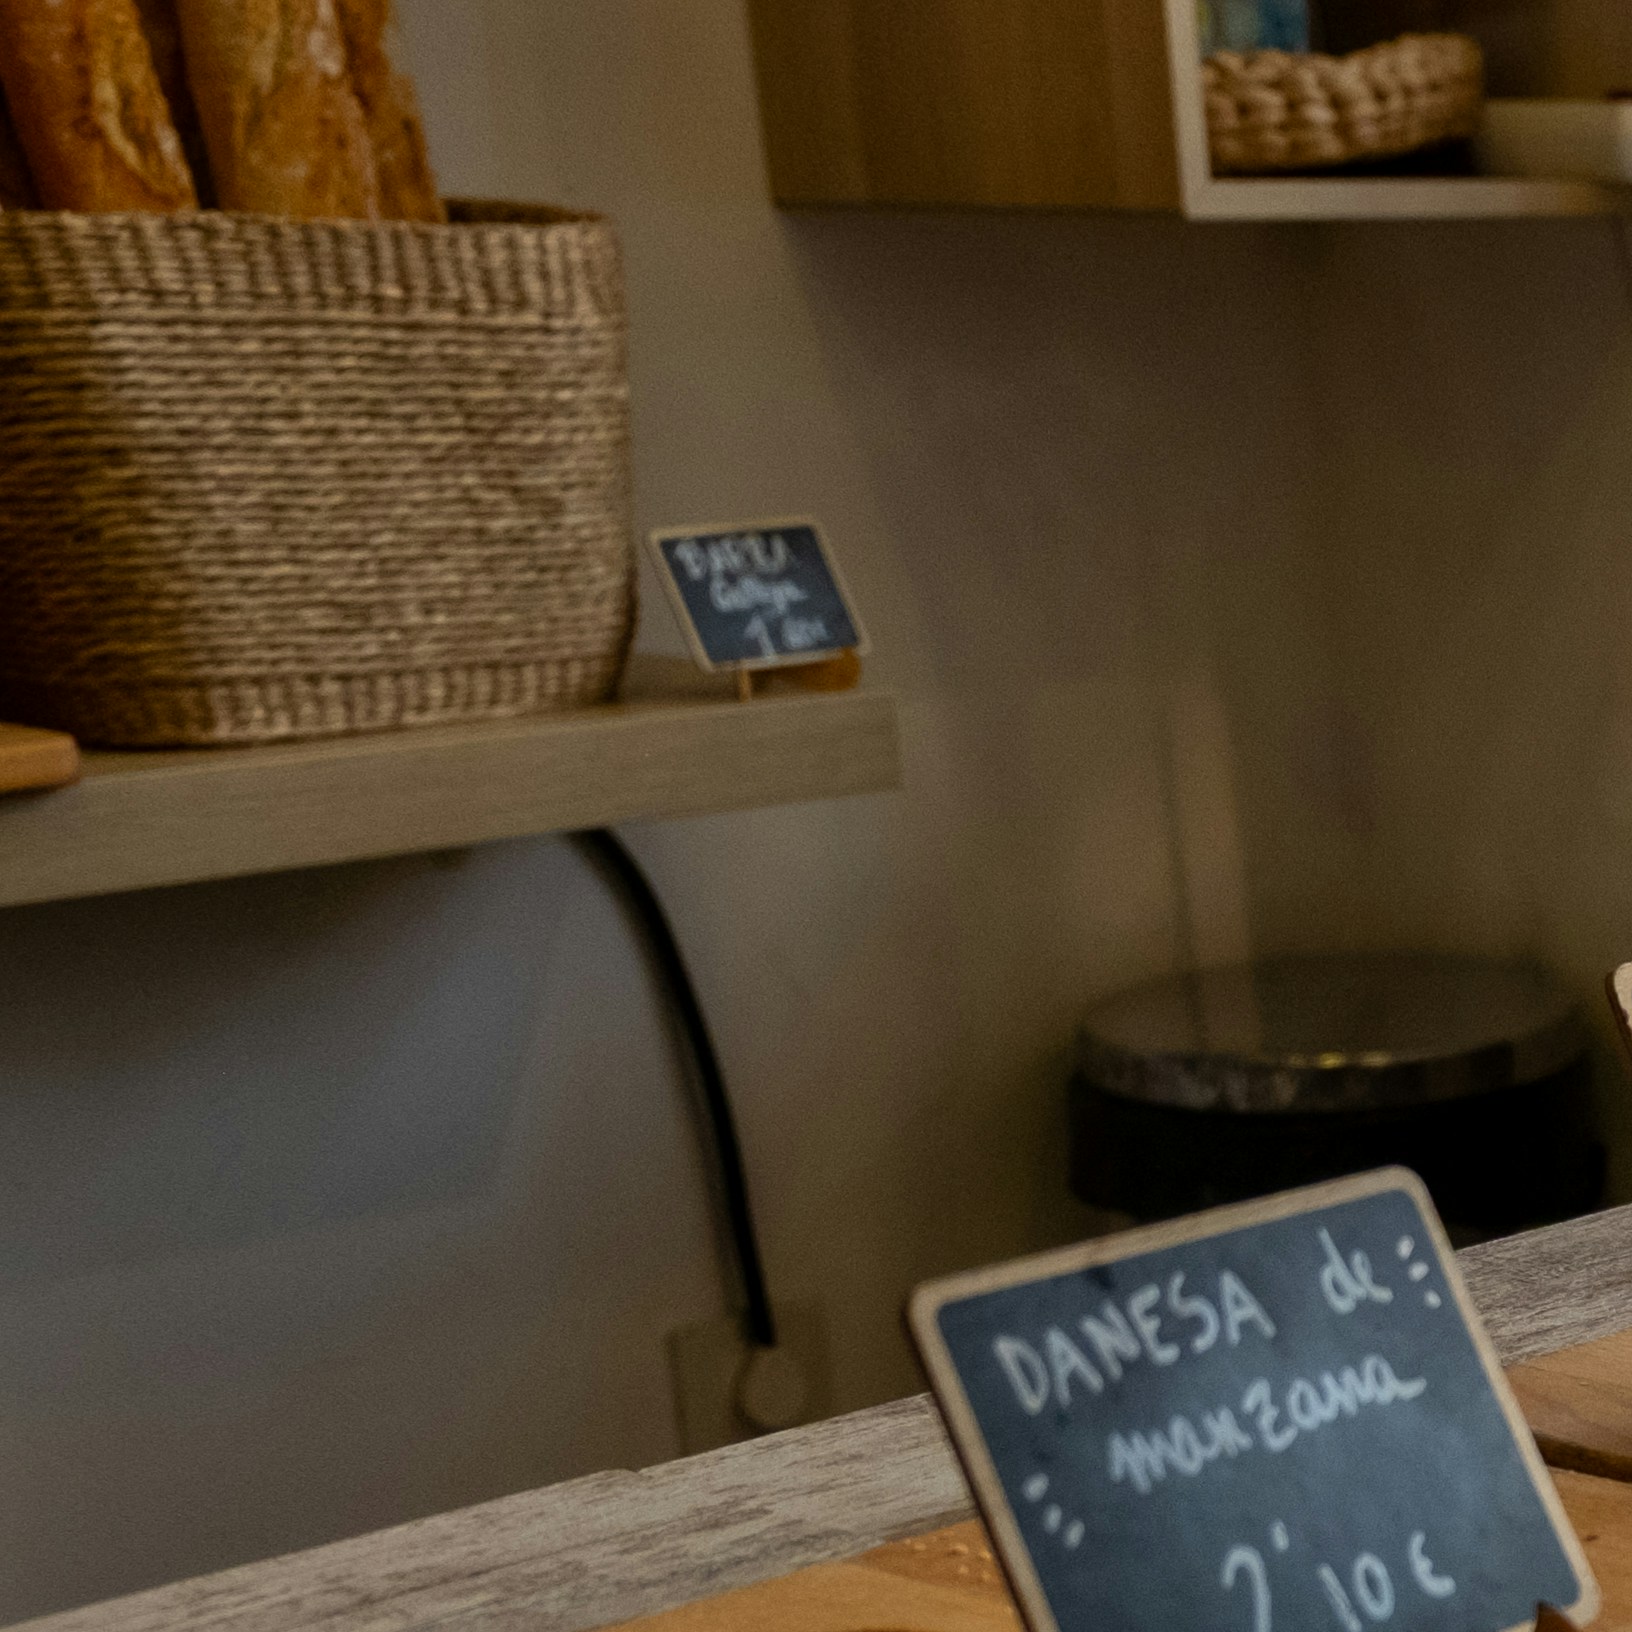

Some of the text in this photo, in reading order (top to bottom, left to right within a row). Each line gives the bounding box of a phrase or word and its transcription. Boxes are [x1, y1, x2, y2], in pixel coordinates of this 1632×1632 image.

[993, 1227, 1393, 1417] DANESA de
[1108, 1354, 1426, 1494] manzana
